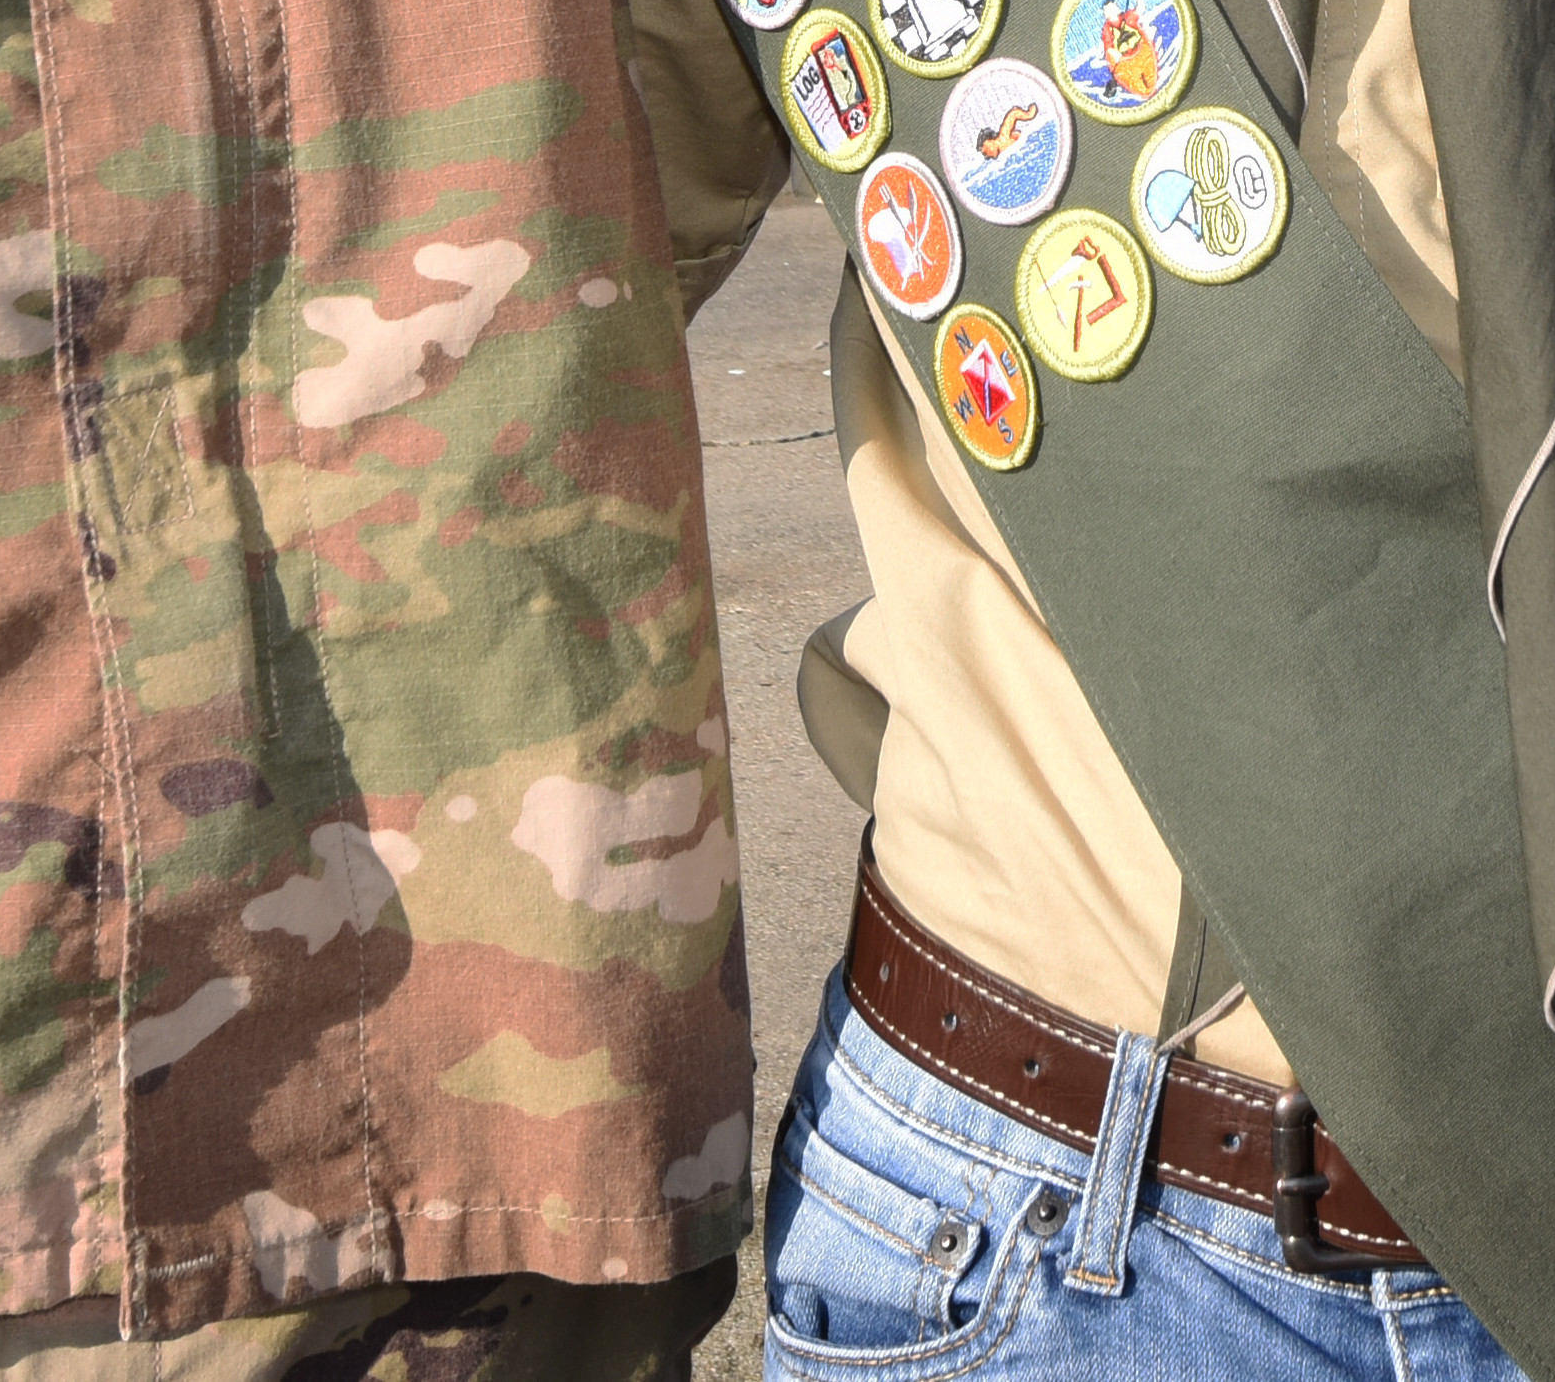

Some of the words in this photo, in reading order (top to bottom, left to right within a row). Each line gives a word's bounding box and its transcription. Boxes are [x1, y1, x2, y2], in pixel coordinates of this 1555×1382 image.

[795, 65, 822, 102] LOG
[954, 326, 974, 357] N
[1000, 350, 1018, 378] E
[997, 417, 1015, 444] S
